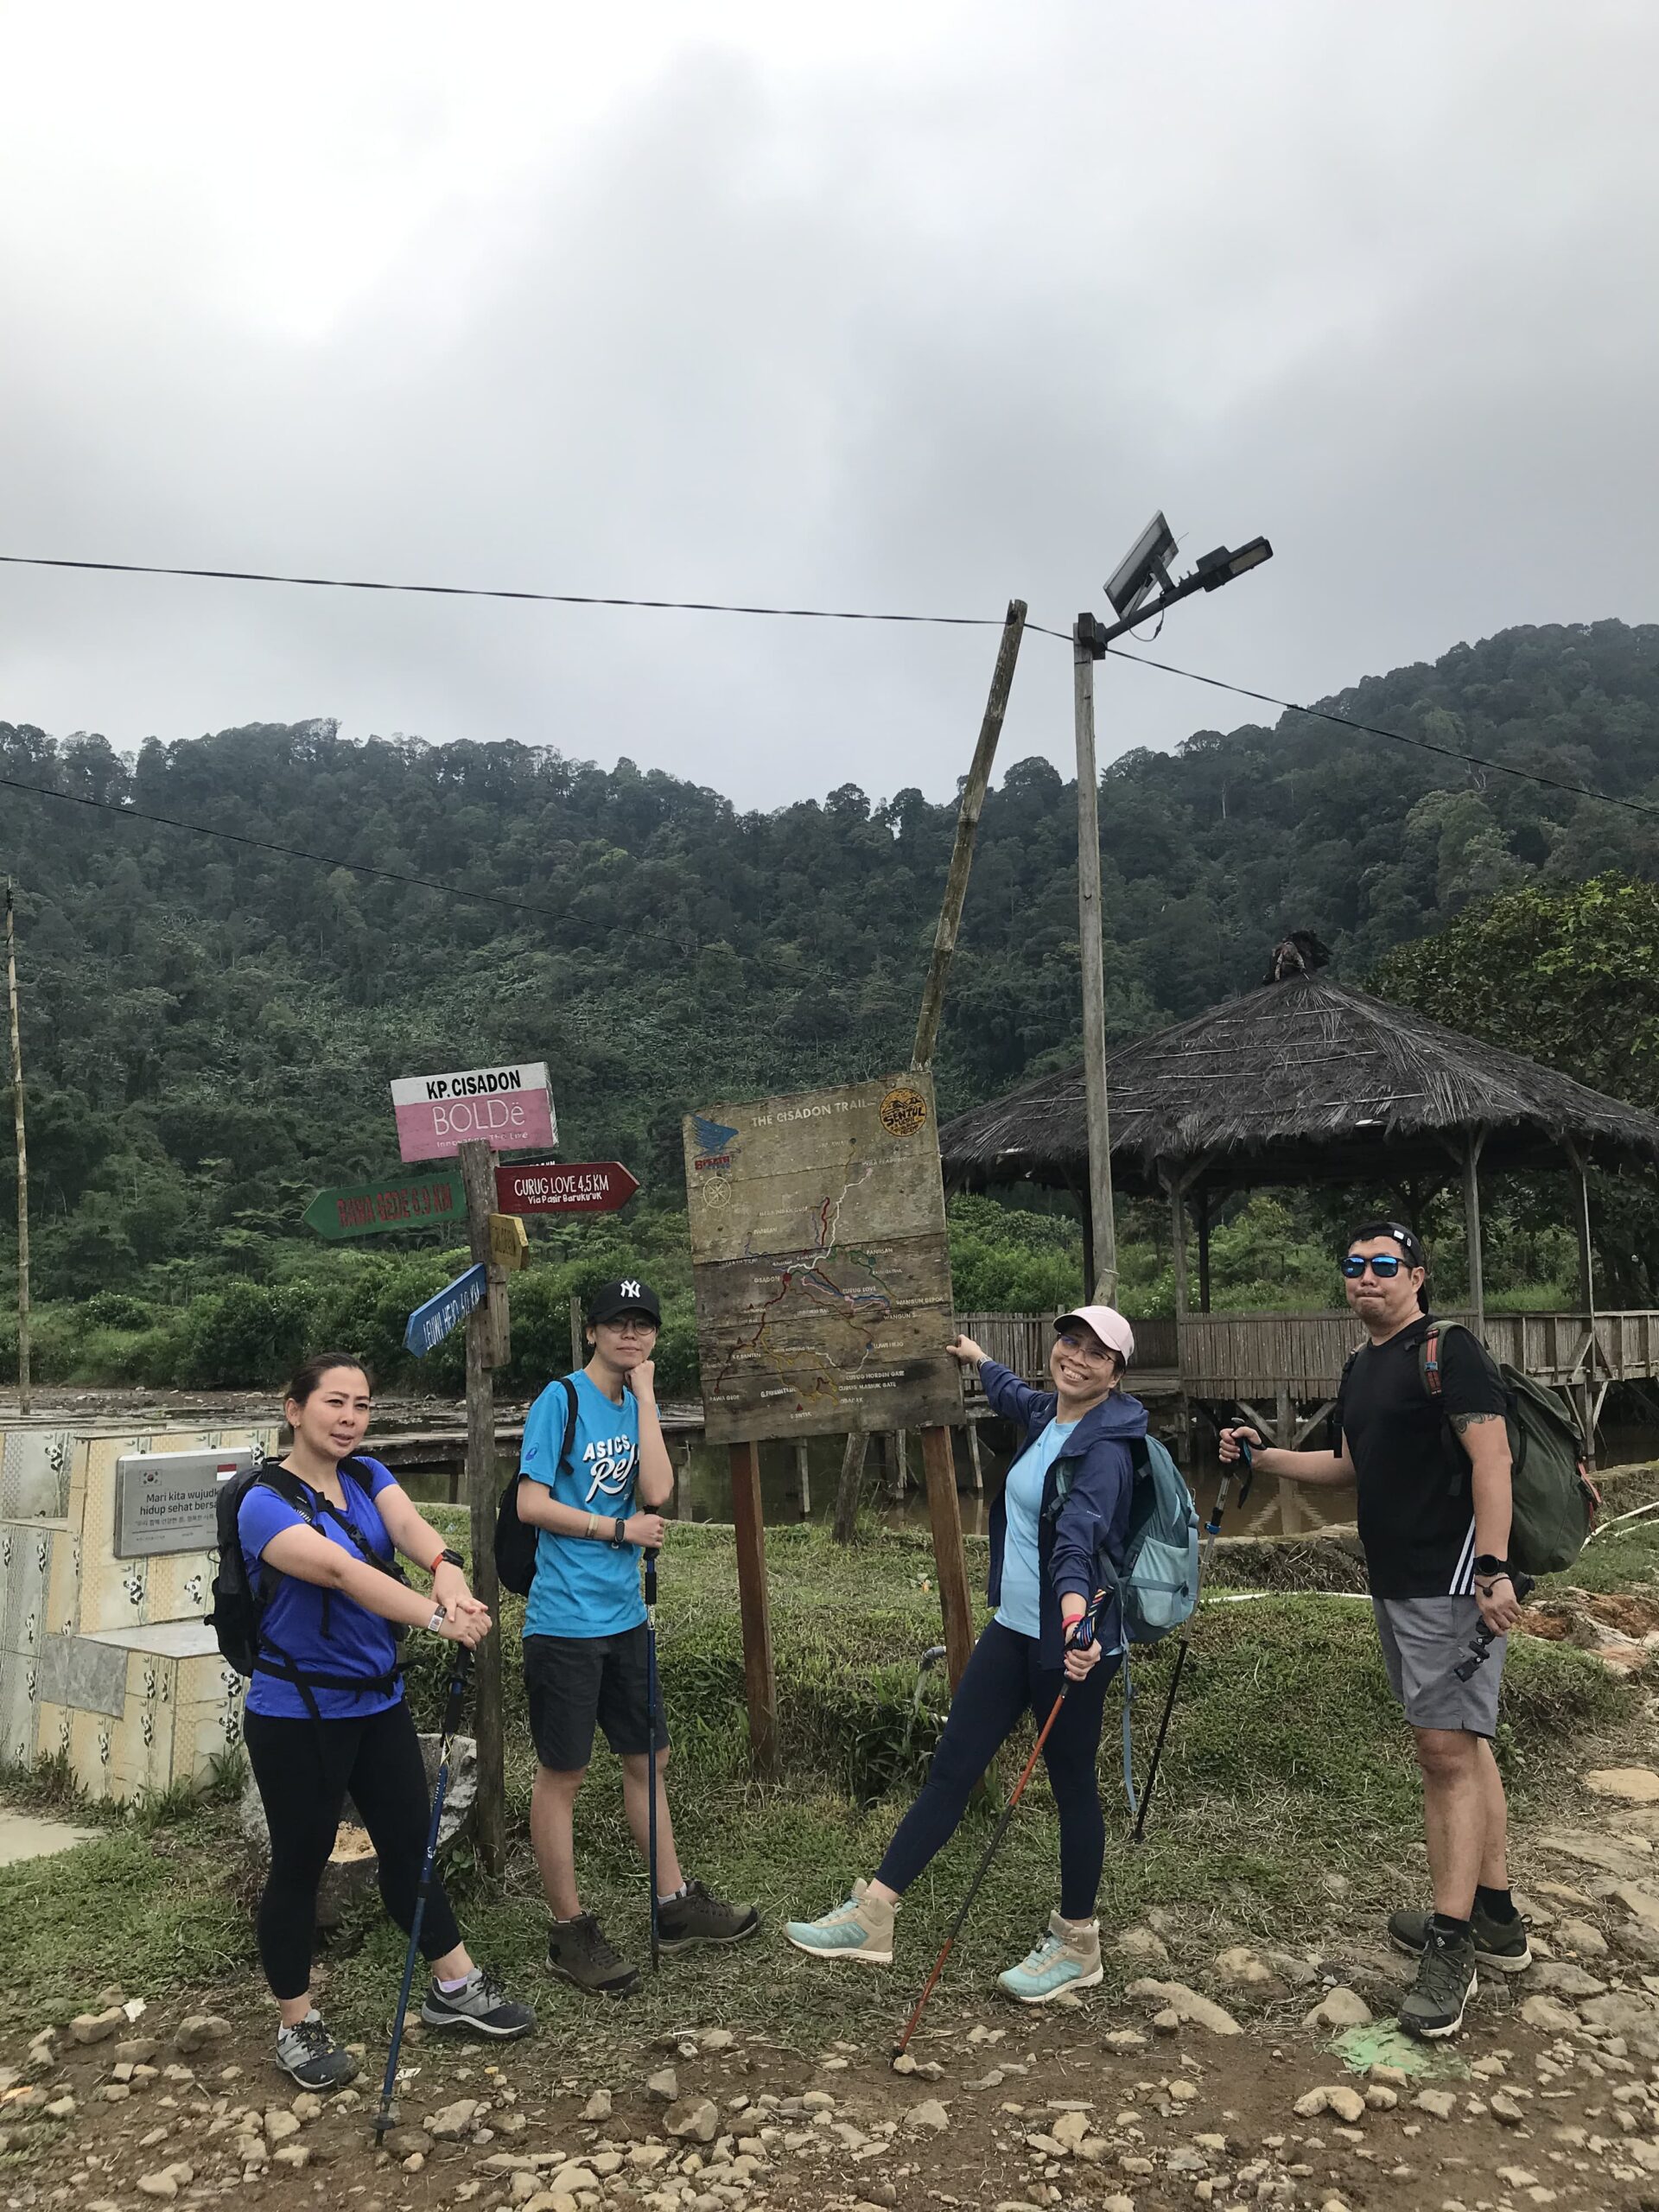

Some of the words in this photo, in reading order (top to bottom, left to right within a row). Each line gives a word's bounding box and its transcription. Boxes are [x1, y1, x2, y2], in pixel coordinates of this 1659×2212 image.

[752, 1115, 772, 1127] THE
[883, 1107, 925, 1127] SENTUL
[514, 1177, 550, 1197] CURUG
[550, 1175, 576, 1194] LOVE
[593, 1173, 609, 1192] KM
[433, 1181, 453, 1212] KM
[527, 1194, 541, 1205] Via
[542, 1193, 562, 1204] Pasir
[620, 1280, 640, 1298] NY
[582, 1433, 631, 1462] ASICS
[146, 1492, 167, 1503] Mari
[168, 1491, 186, 1502] kita
[139, 1505, 166, 1516] hidup
[168, 1503, 193, 1513] sehat
